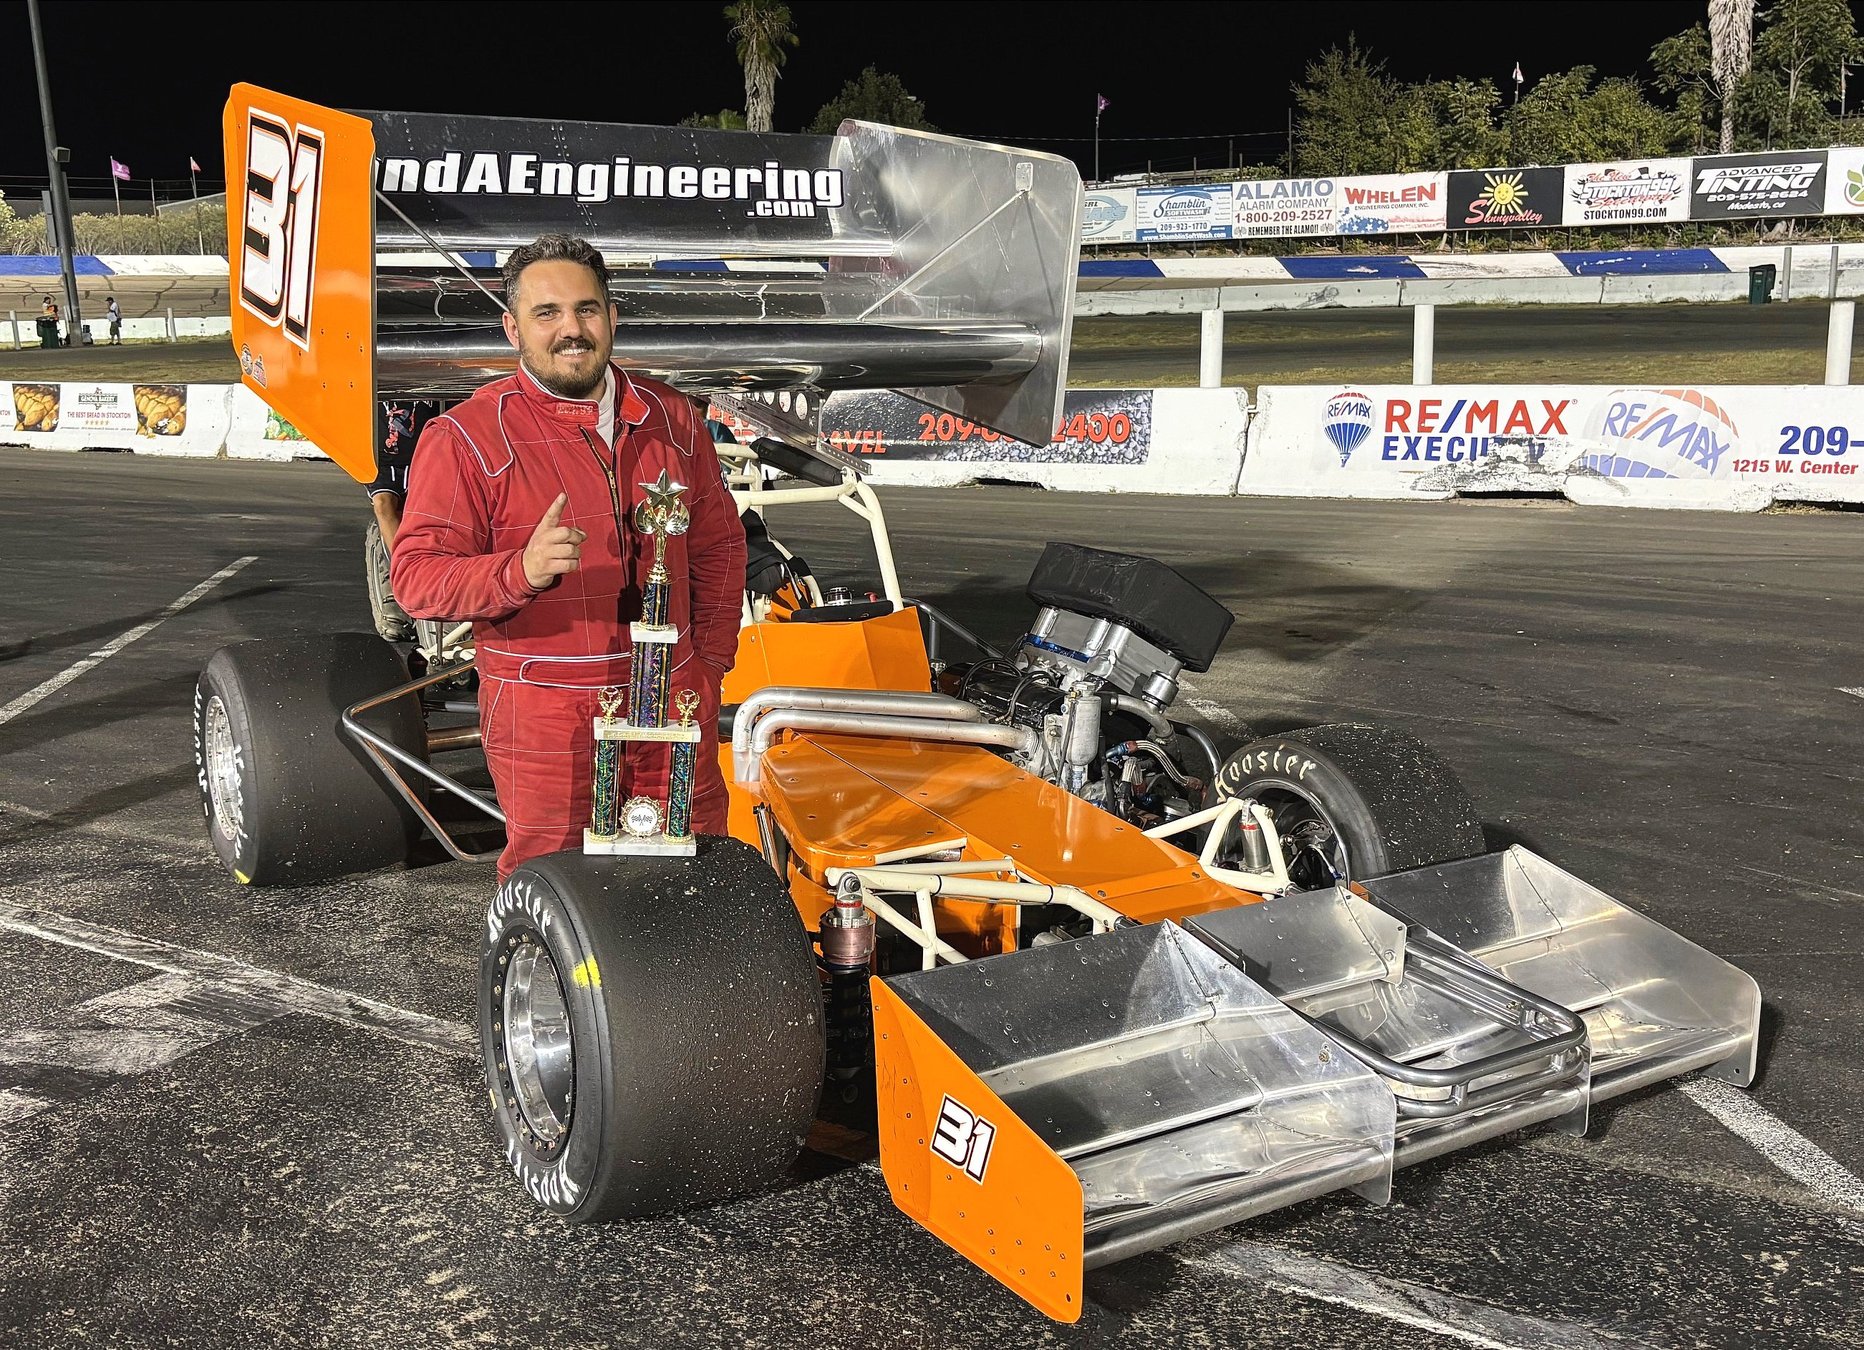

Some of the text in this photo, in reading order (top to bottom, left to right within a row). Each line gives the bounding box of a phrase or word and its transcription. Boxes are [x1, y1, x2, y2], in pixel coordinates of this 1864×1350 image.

[376, 152, 842, 206] ndAEngineering
[1717, 166, 1803, 176] ADVANCED
[1235, 180, 1334, 200] ALAMO
[1696, 168, 1818, 194] TINTING
[1344, 182, 1436, 204] WHELEN
[1707, 190, 1809, 202] 209-575-2624
[747, 201, 815, 216] .com
[1153, 196, 1206, 218] Shamblin
[1240, 198, 1329, 211] ALARM COMPANY
[1465, 199, 1543, 226] Sunnyvalley
[1584, 208, 1667, 220] STOCKTON99.COM
[1727, 202, 1770, 210] Modesto,
[1235, 209, 1333, 223] 1-800-209-2527
[240, 107, 324, 351] 31
[1160, 222, 1208, 231] 209-923-1770
[1248, 226, 1280, 236] REMEMBER
[1281, 225, 1293, 235] THE
[1327, 401, 1372, 419] RE/MAX
[1385, 399, 1571, 435] RE/MAX
[819, 430, 887, 454] AVEL
[1602, 402, 1731, 476] RE/MAX
[1732, 459, 1859, 475] 1215 W. Center
[930, 1093, 997, 1185] 31
